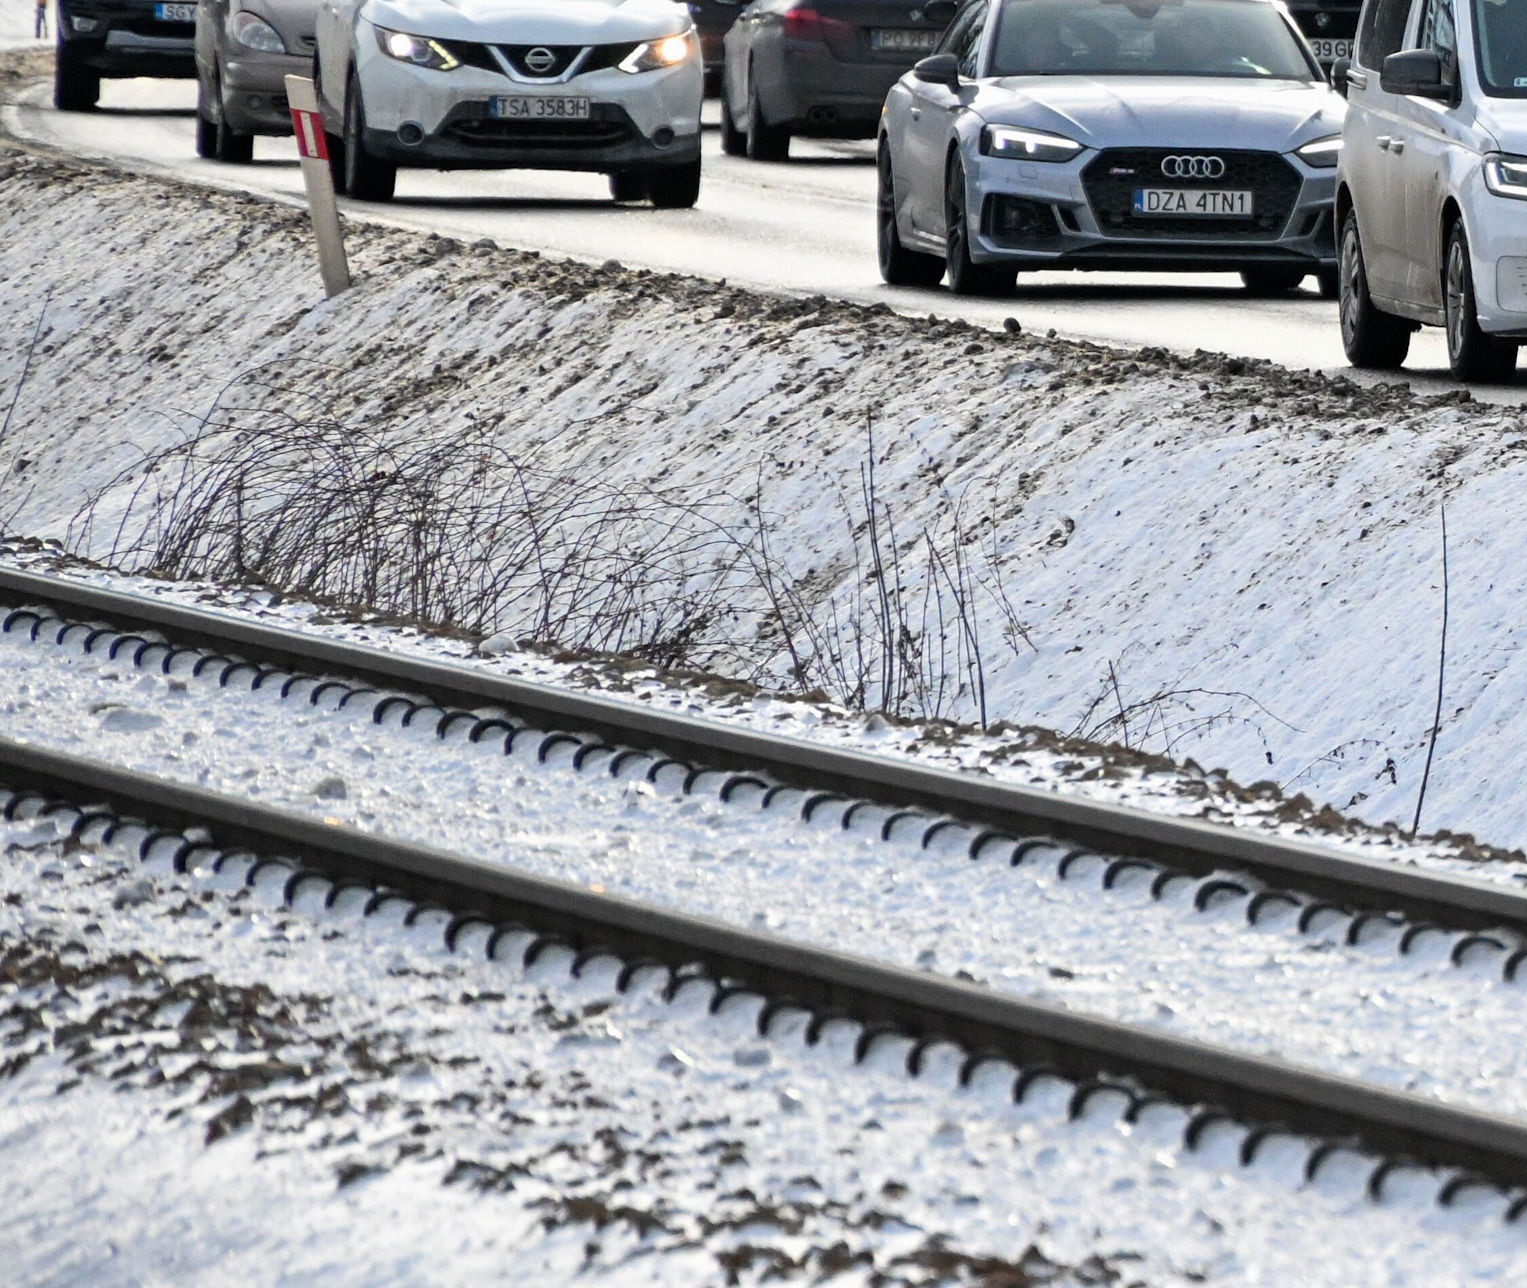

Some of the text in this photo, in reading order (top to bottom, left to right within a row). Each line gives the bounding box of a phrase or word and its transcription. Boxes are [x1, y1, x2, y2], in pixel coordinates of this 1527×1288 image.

[498, 98, 587, 116] TSA 3583H
[1147, 191, 1187, 211] DZA
[1196, 193, 1245, 212] 4TN1
